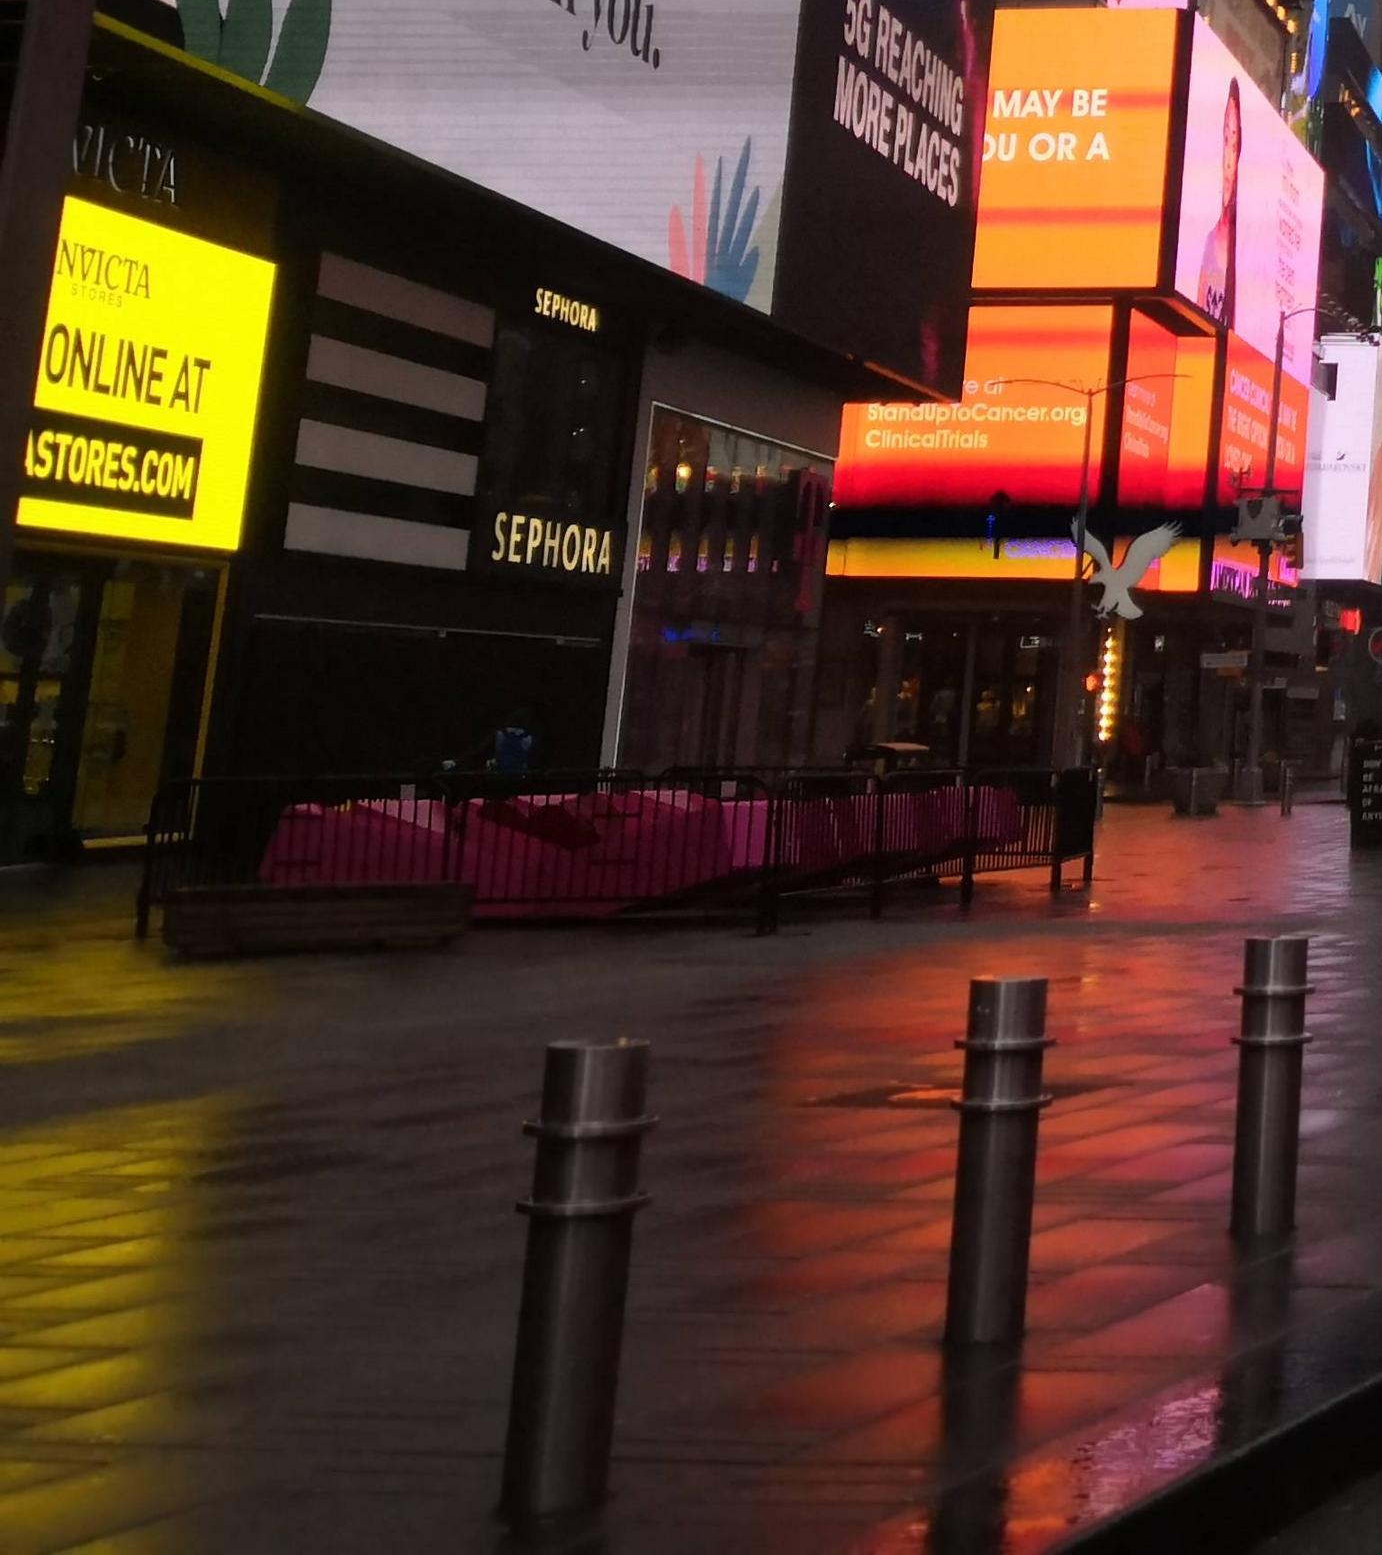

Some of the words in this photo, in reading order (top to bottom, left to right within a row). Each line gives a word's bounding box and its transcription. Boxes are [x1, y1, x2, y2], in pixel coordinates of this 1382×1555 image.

[874, 1, 965, 136] REACHING
[992, 89, 1064, 118] MAY
[1072, 89, 1108, 117] BE
[833, 55, 892, 159] MORE
[893, 105, 961, 209] PLACES
[1028, 133, 1077, 162] OR
[1085, 133, 1112, 162] A
[71, 283, 125, 309] STORES
[534, 287, 599, 333] SEPHORA
[45, 322, 168, 407] ONLINE
[168, 353, 212, 415] AT
[865, 429, 990, 450] ClinicalTrials
[491, 511, 612, 575] SEPHORA
